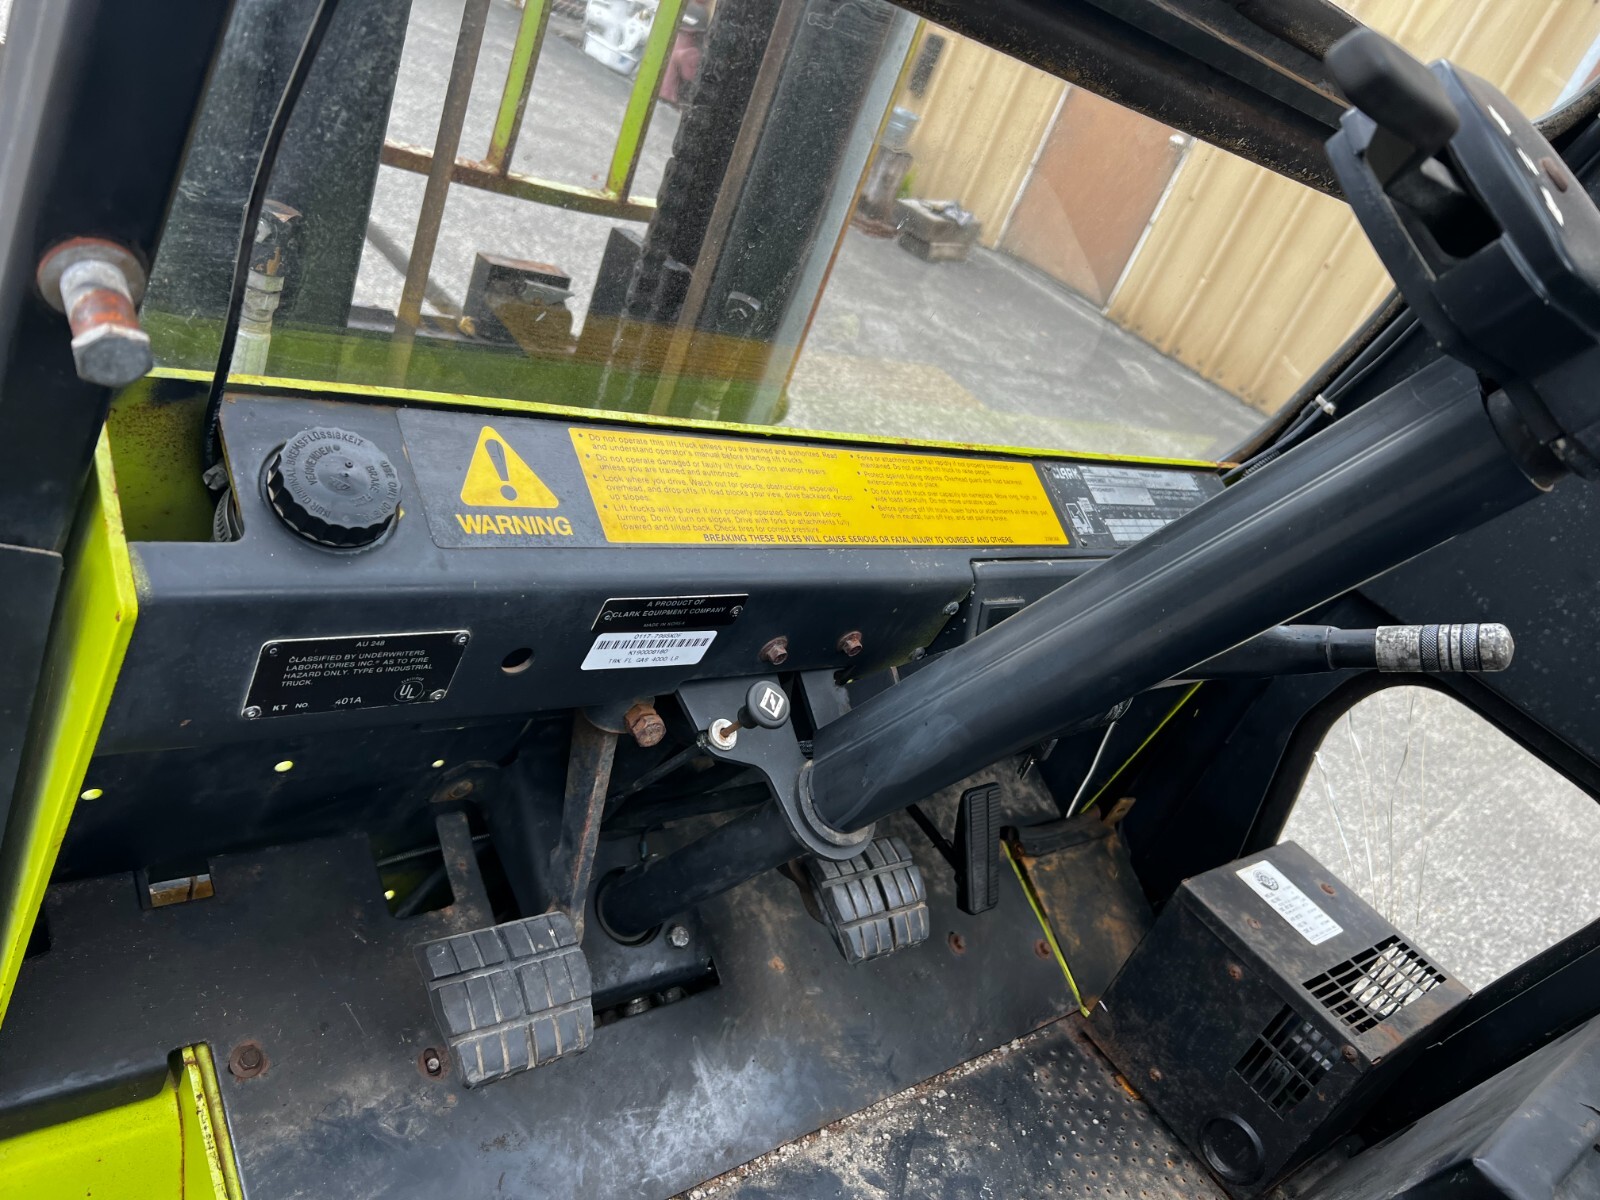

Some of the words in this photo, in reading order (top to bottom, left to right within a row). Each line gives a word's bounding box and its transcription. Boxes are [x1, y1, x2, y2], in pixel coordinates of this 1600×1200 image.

[619, 436, 647, 444] operate
[610, 445, 653, 453] understand
[656, 448, 692, 457] operator's
[626, 457, 654, 466] operate
[658, 458, 690, 468] damaged
[456, 514, 573, 535] WARNING
[703, 533, 746, 542] BREAKING
[642, 608, 689, 617] EQUIPMENT
[289, 654, 342, 663] CLASSIFIED
[358, 649, 426, 659] UNDERWRITERS
[286, 661, 355, 671] LABORATORIES
[385, 664, 432, 672] INDUSTRIAL
[400, 684, 415, 699] UL
[335, 696, 362, 705] 401A
